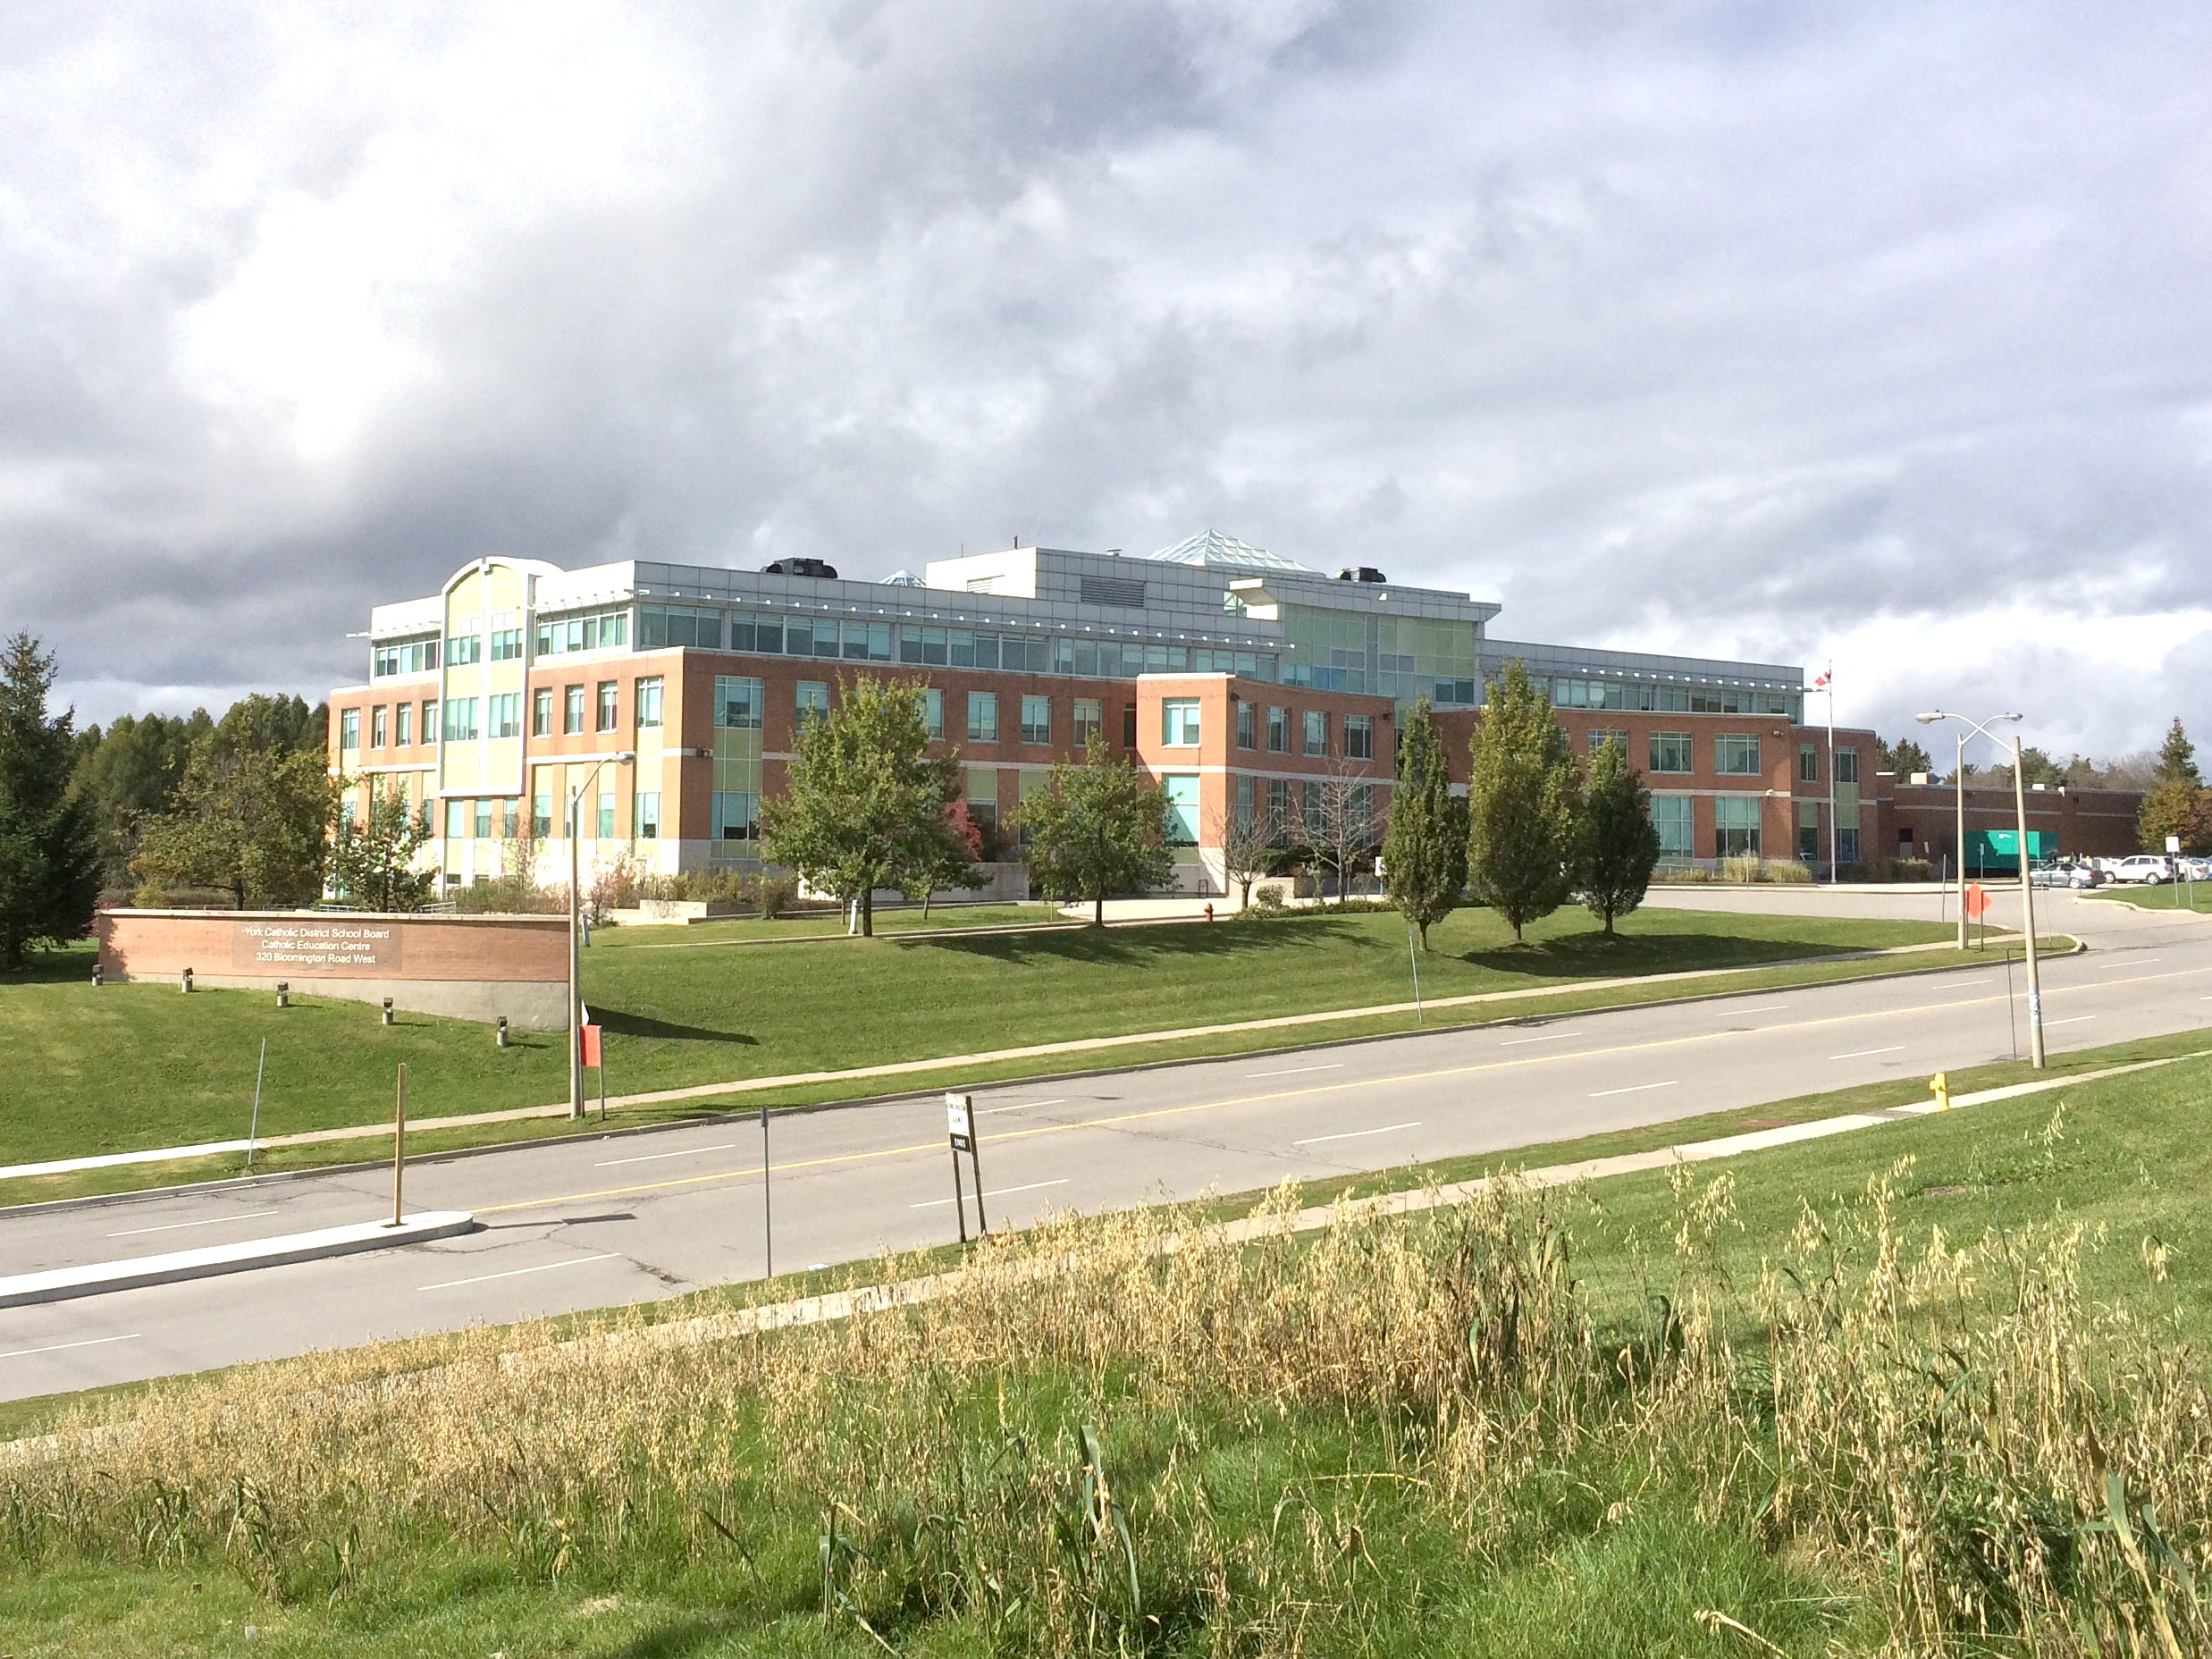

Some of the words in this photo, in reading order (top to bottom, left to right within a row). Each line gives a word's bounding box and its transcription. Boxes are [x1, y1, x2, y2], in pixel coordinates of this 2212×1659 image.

[245, 927, 263, 937] York
[265, 927, 299, 937] Catholic
[299, 928, 330, 938] District
[332, 929, 361, 939] School
[364, 929, 390, 939] Board
[261, 939, 296, 949] Catholic
[297, 940, 340, 950] Education
[341, 940, 371, 951] Centre
[256, 951, 273, 962] 320
[273, 952, 326, 964] Bloomington
[328, 954, 351, 964] Road
[353, 954, 376, 964] West
